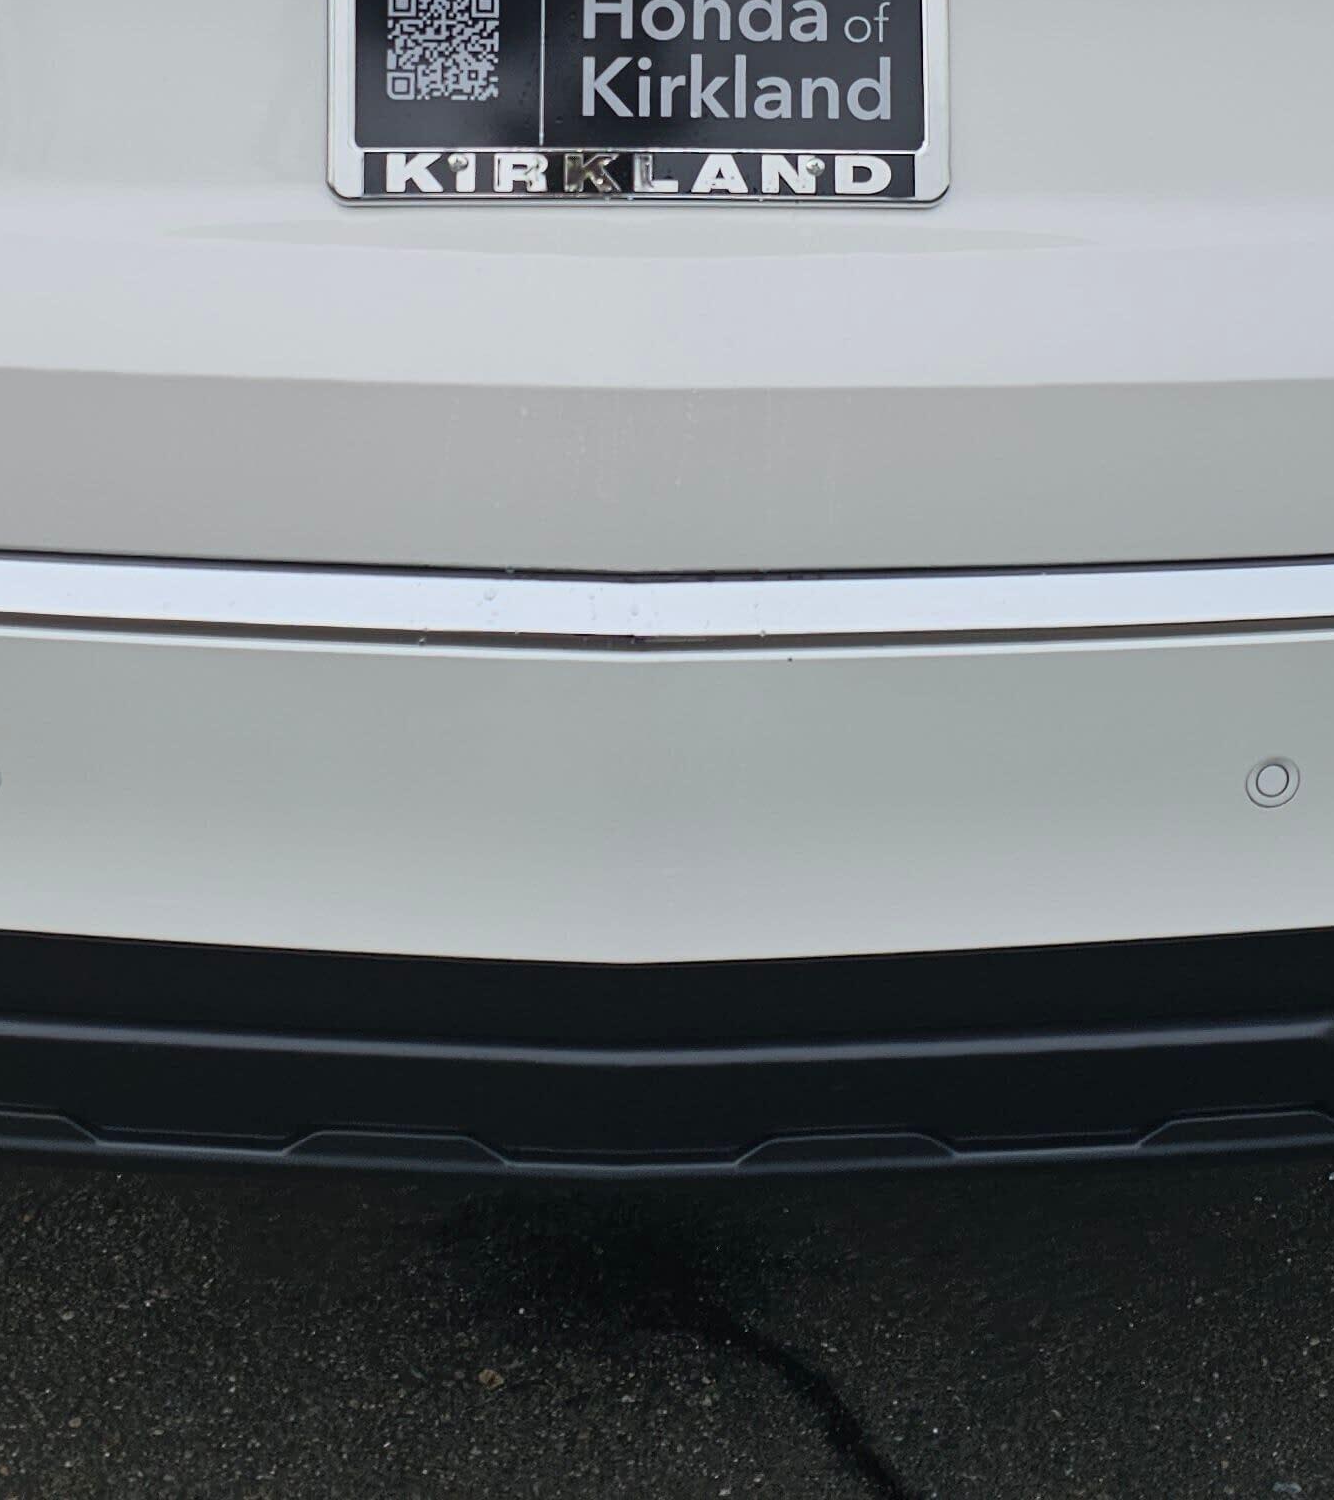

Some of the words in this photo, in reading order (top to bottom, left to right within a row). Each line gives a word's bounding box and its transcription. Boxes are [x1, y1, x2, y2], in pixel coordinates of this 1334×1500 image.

[843, 1, 891, 43] of
[581, 53, 892, 120] Kirkland
[384, 152, 893, 195] KIRKLAND
